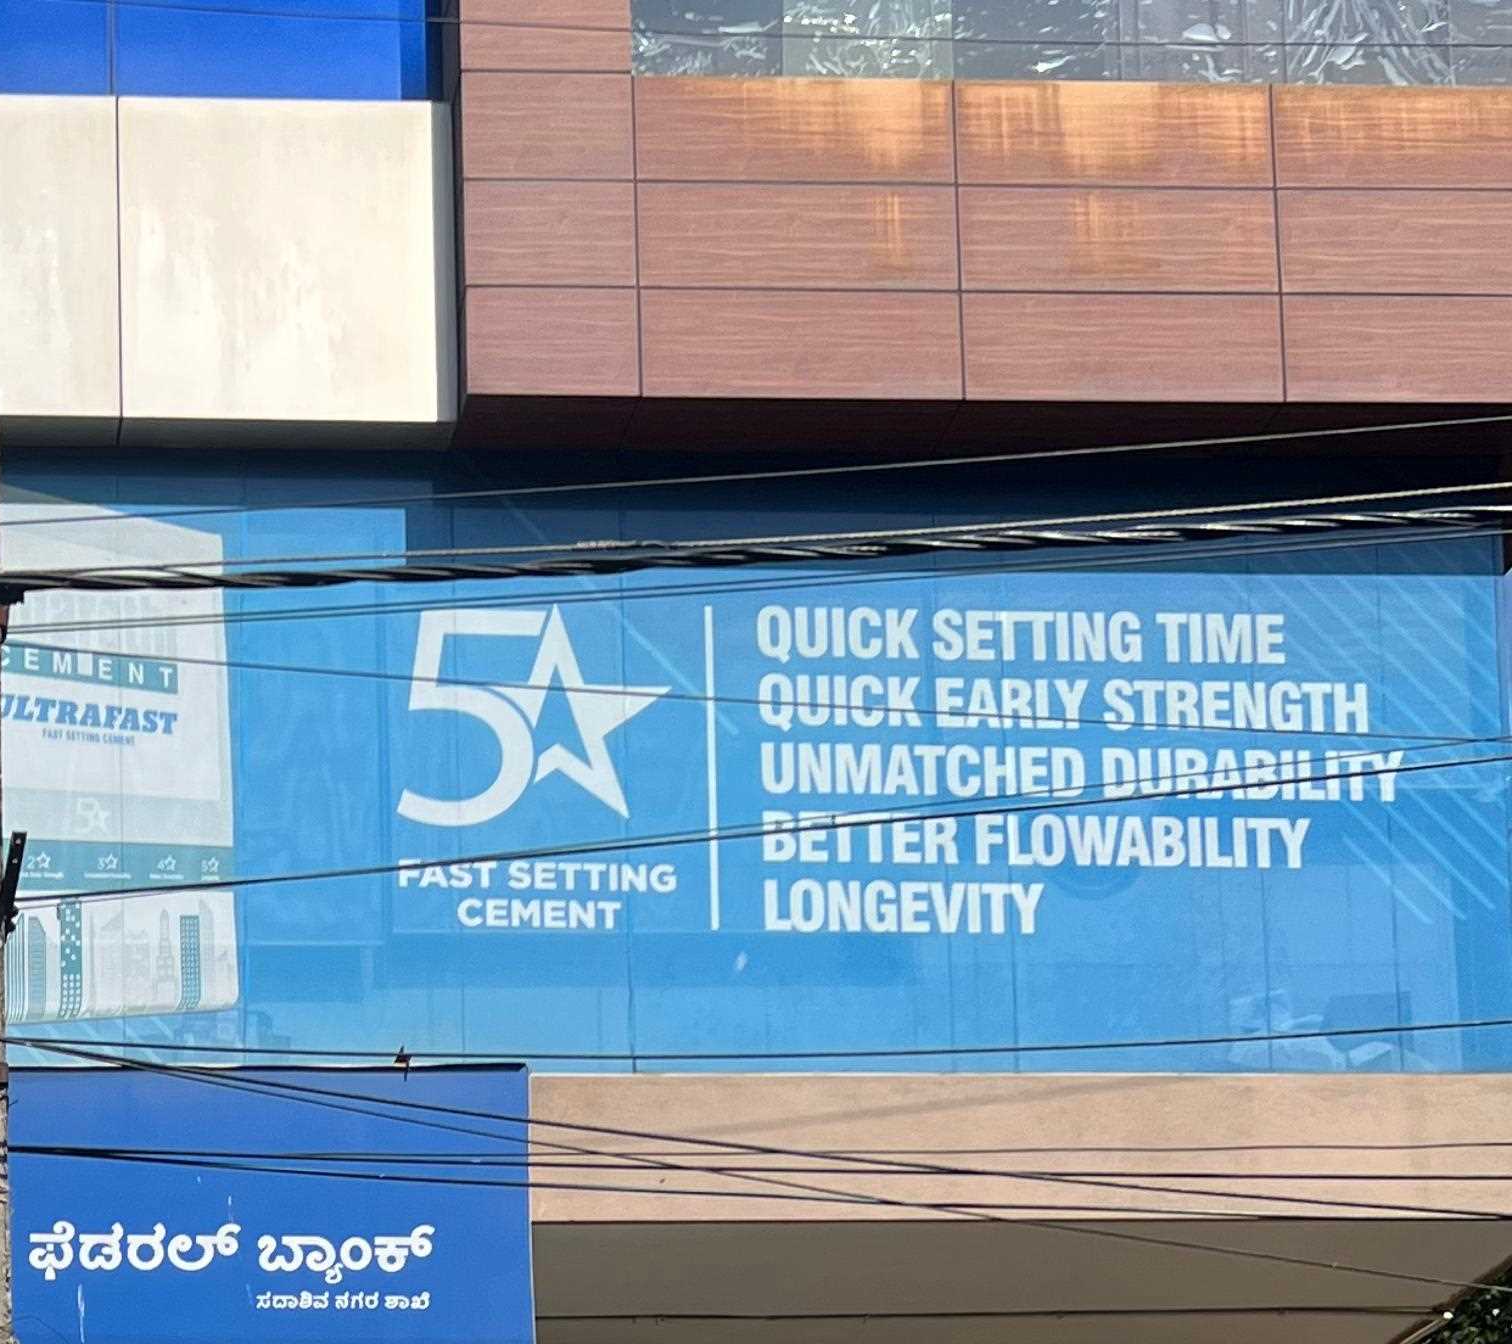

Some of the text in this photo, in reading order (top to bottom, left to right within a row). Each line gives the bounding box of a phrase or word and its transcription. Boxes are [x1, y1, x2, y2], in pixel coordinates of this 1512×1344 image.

[756, 604, 1286, 665] QUICK SETTING TIME
[757, 672, 1370, 734] QUICK EARLY STRENGTH
[760, 741, 1405, 803] UNMATCHED DURABILITY
[761, 810, 1311, 869] BETTER FLOWABILITY
[396, 858, 679, 893] FAST SETTING
[456, 897, 622, 930] CEMENT
[763, 876, 1045, 935] LONGEVITY
[28, 1219, 436, 1285] ಫೆಡರಲ್ ಬ್ಯಾಂಕ್
[335, 1292, 380, 1311] ನಗರ
